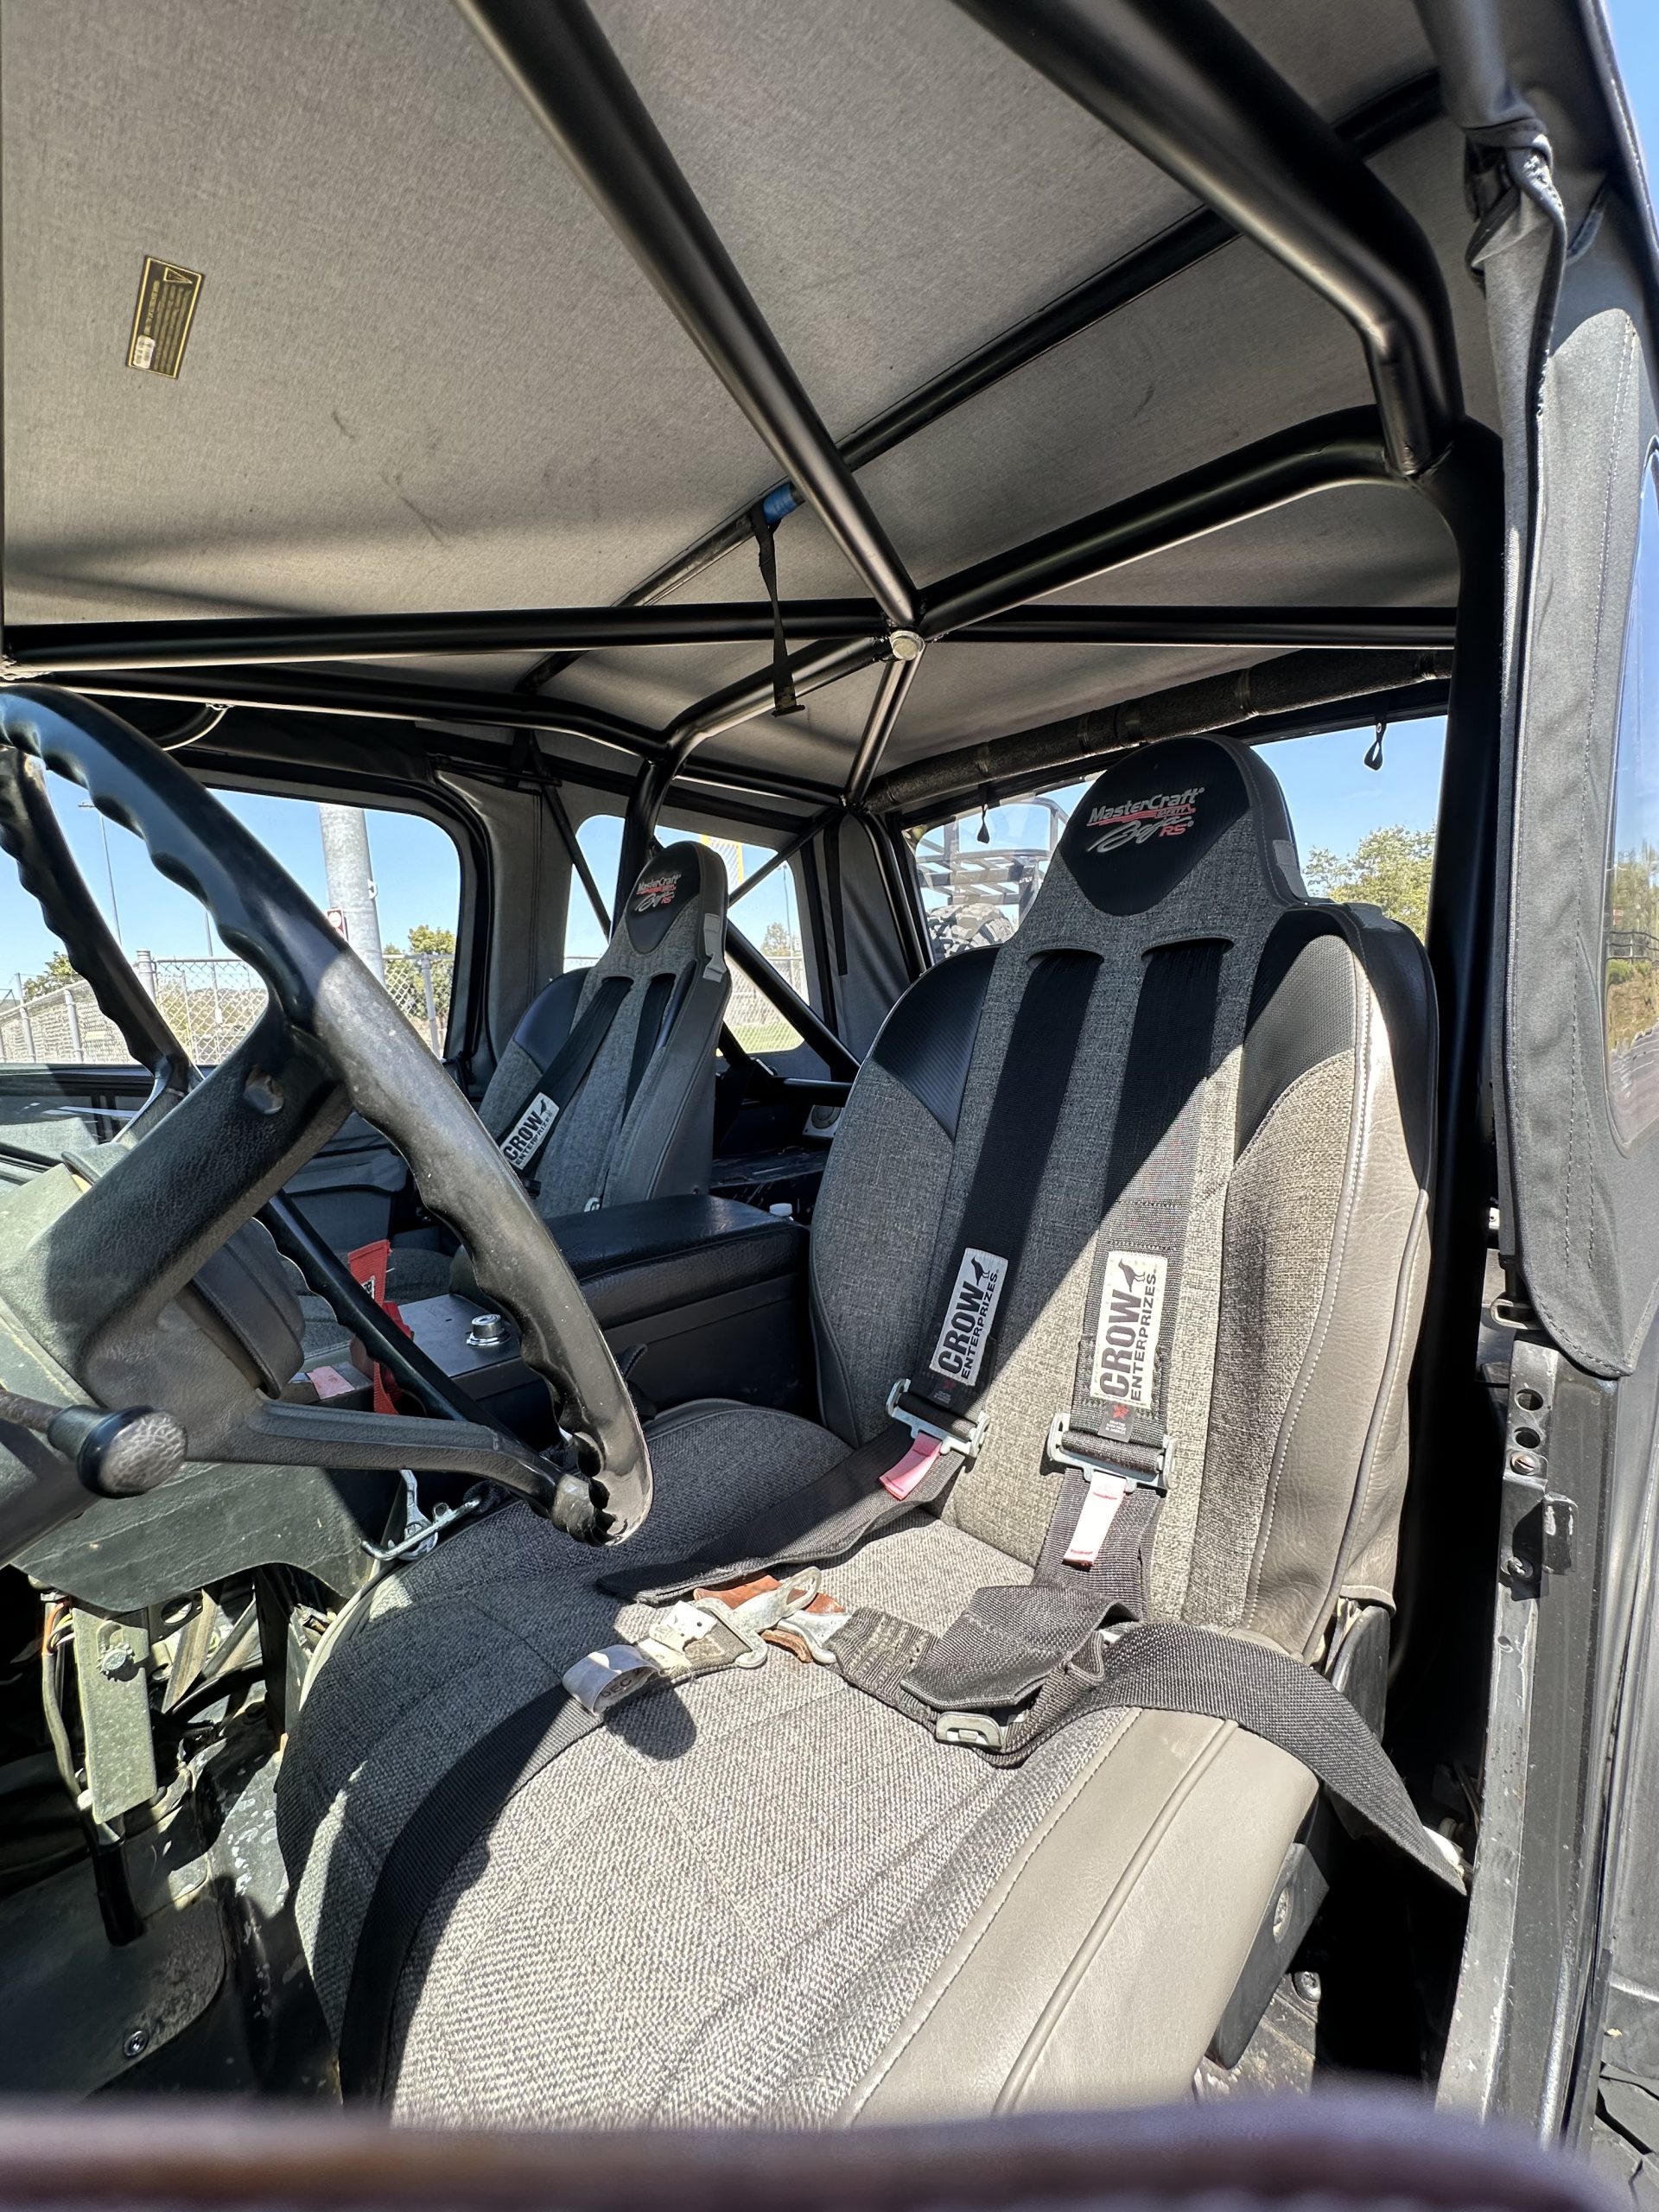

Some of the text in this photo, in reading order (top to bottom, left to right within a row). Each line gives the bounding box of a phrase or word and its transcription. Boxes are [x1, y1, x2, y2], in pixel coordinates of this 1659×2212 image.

[1089, 787, 1198, 823] MasterCraft
[1159, 824, 1187, 836] RS
[503, 1110, 543, 1161] CROW
[938, 1280, 985, 1375] CROW
[960, 1272, 998, 1380] ENTERPRIZES
[1099, 1288, 1142, 1398] CROW
[1130, 1273, 1157, 1402] ENTERPRIZES
